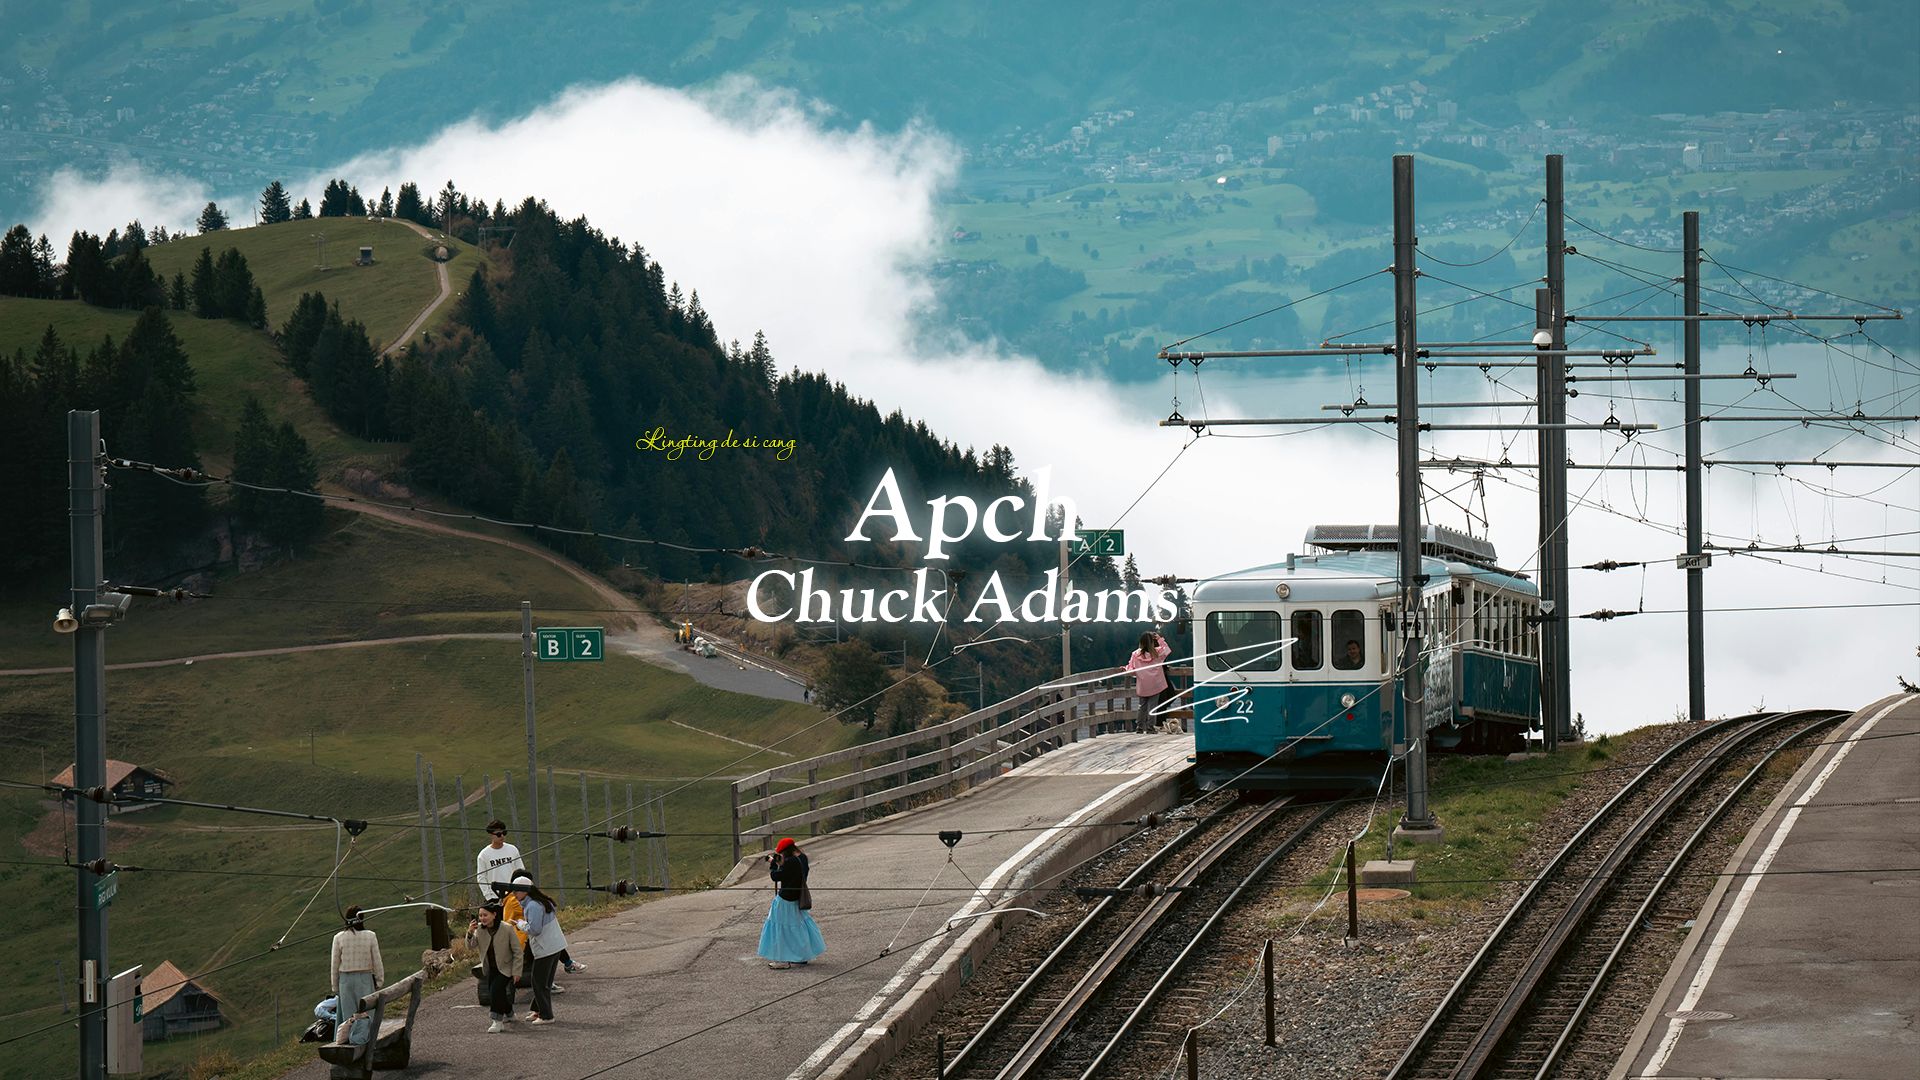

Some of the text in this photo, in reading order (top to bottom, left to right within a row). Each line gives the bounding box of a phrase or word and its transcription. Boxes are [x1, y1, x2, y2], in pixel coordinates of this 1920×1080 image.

[1079, 538, 1115, 552] A 2
[547, 639, 592, 656] B 2
[1236, 700, 1254, 714] 22
